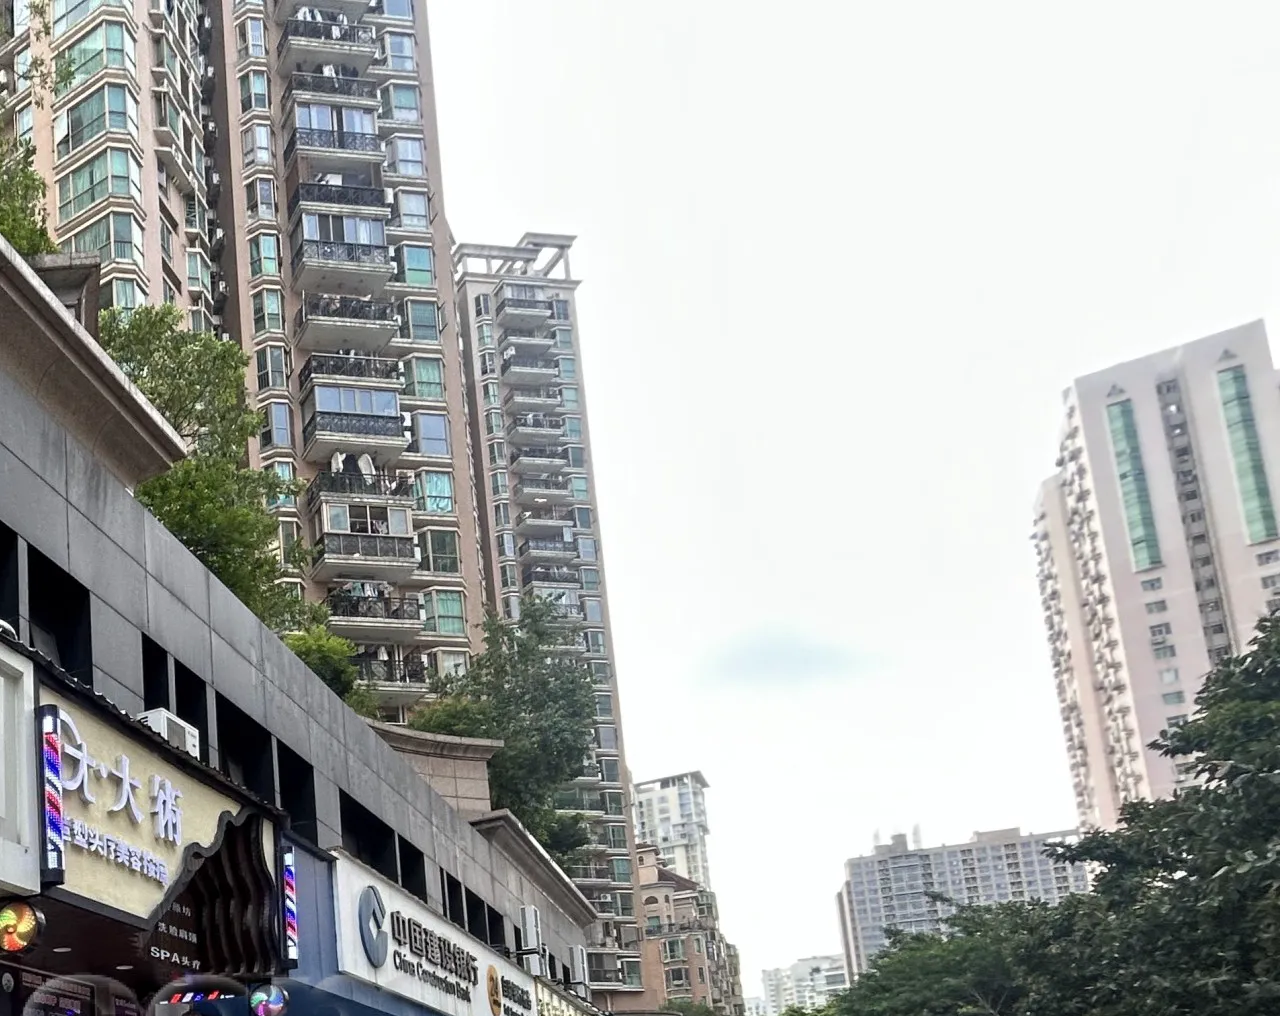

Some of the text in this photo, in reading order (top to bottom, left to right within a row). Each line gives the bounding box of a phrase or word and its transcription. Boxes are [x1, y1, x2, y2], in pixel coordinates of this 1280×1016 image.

[390, 911, 479, 987] 中国建设银行
[393, 949, 416, 977] China
